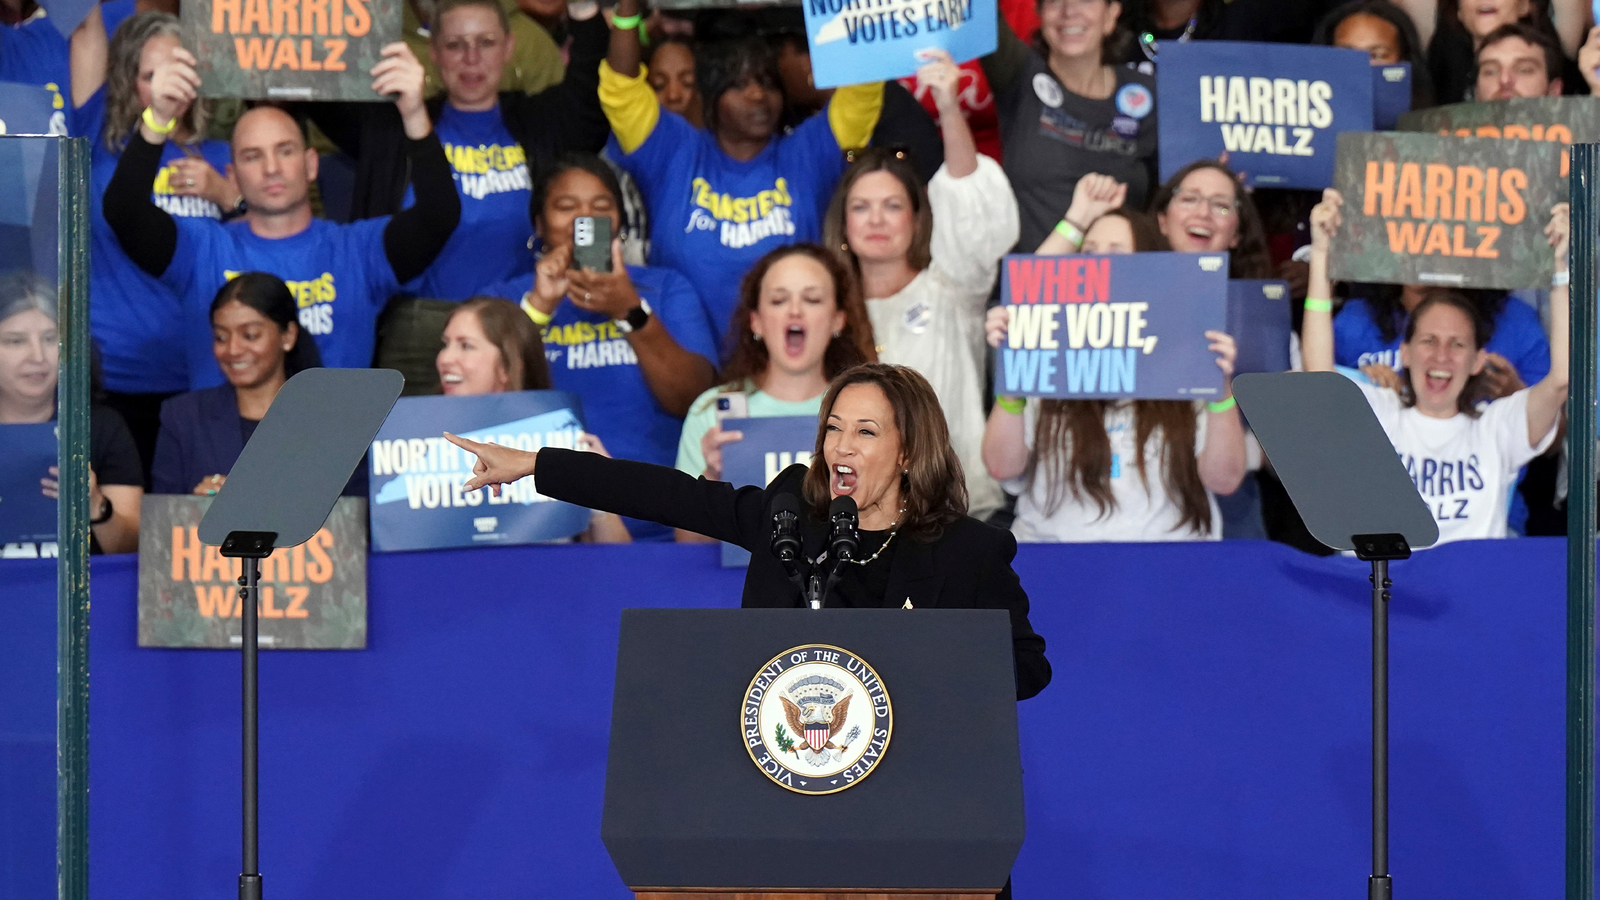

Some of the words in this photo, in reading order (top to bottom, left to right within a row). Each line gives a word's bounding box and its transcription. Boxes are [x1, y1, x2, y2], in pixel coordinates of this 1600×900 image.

[210, 0, 372, 36] HARRIS
[843, 7, 918, 45] VOTES
[234, 37, 348, 71] WALZ
[1199, 75, 1334, 129] HARRIS
[1221, 123, 1315, 157] WALZ
[1362, 160, 1528, 226] HARRIS
[684, 207, 717, 234] for
[719, 205, 796, 249] HARRIS
[1385, 221, 1501, 259] WALZ
[1007, 258, 1111, 305] WHEN
[1006, 304, 1061, 350] WE
[1065, 301, 1158, 355] VOTE,
[1003, 348, 1058, 393] WE
[1065, 347, 1137, 393] WIN
[373, 436, 459, 476] NORTH
[1398, 454, 1484, 497] ARRIS
[406, 472, 483, 510] VOTES
[171, 525, 335, 584] HARIS
[195, 586, 309, 619] WLZ
[790, 651, 808, 665] OF
[814, 650, 840, 664] THE
[744, 659, 784, 748] PRESIDENT
[846, 657, 888, 718] UNITED
[758, 751, 793, 787] VICE
[843, 727, 887, 783] STATES
